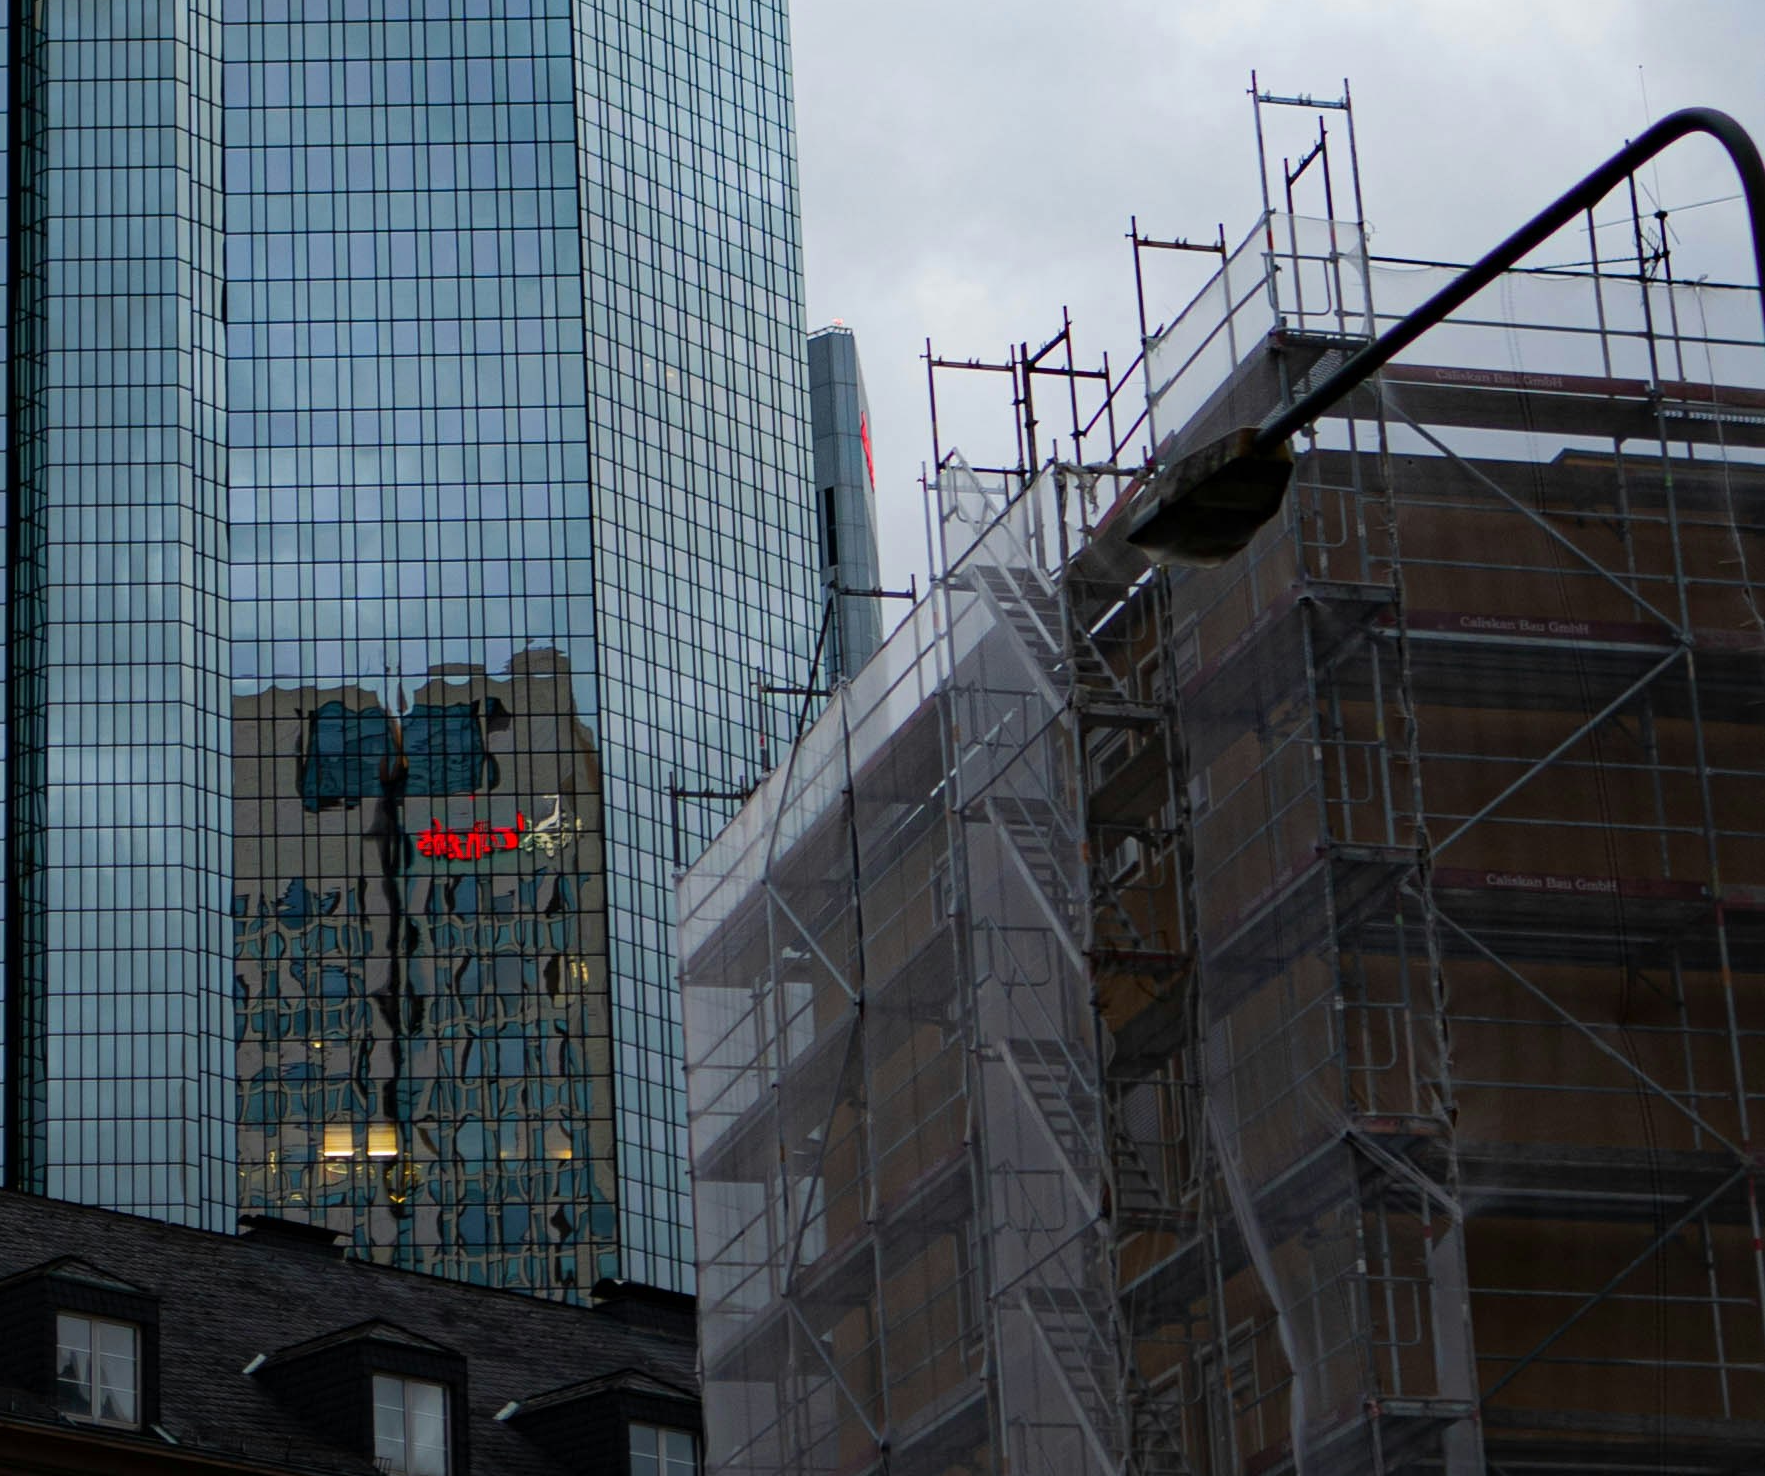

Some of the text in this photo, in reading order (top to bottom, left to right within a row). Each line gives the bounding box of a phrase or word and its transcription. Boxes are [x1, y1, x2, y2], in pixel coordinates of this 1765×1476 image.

[1459, 615, 1589, 635] Caliskan Bau GmbH
[1485, 873, 1618, 892] Caliskan Bau GmbH
